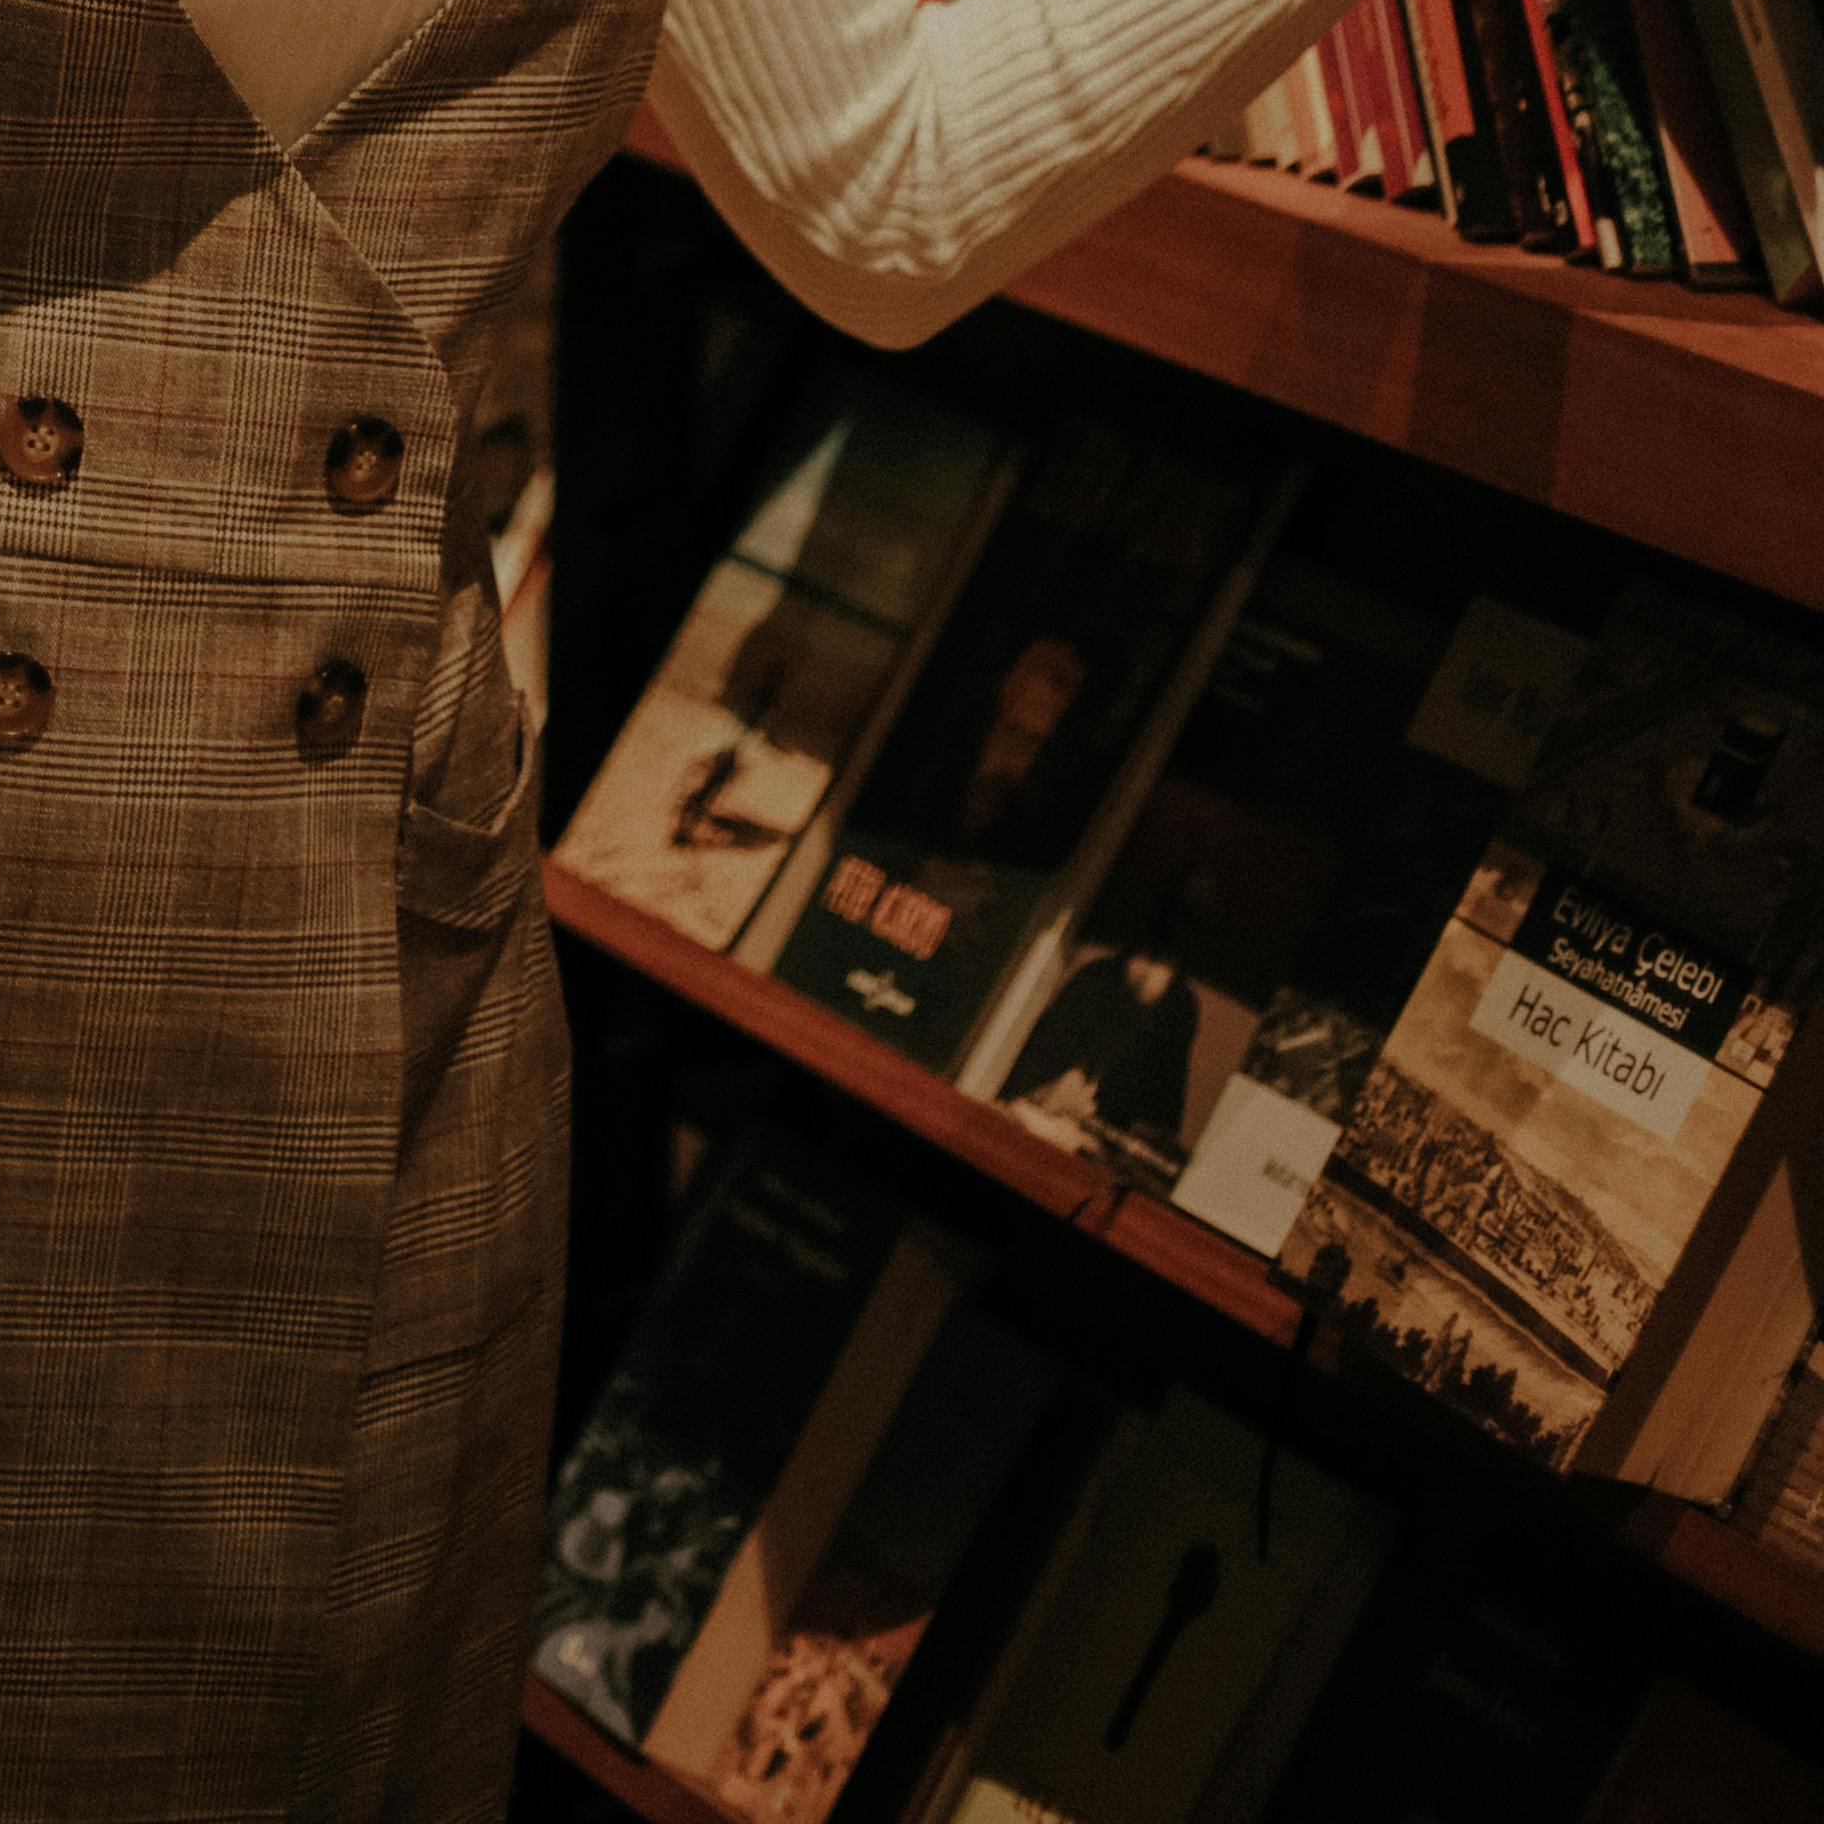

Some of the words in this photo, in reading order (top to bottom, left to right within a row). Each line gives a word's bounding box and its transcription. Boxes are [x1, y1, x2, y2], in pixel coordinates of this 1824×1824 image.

[1552, 886, 1633, 956] Evliya
[1634, 932, 1725, 1005] Çelebi
[1509, 983, 1572, 1048] Hac
[1574, 1020, 1666, 1101] Kitabı
